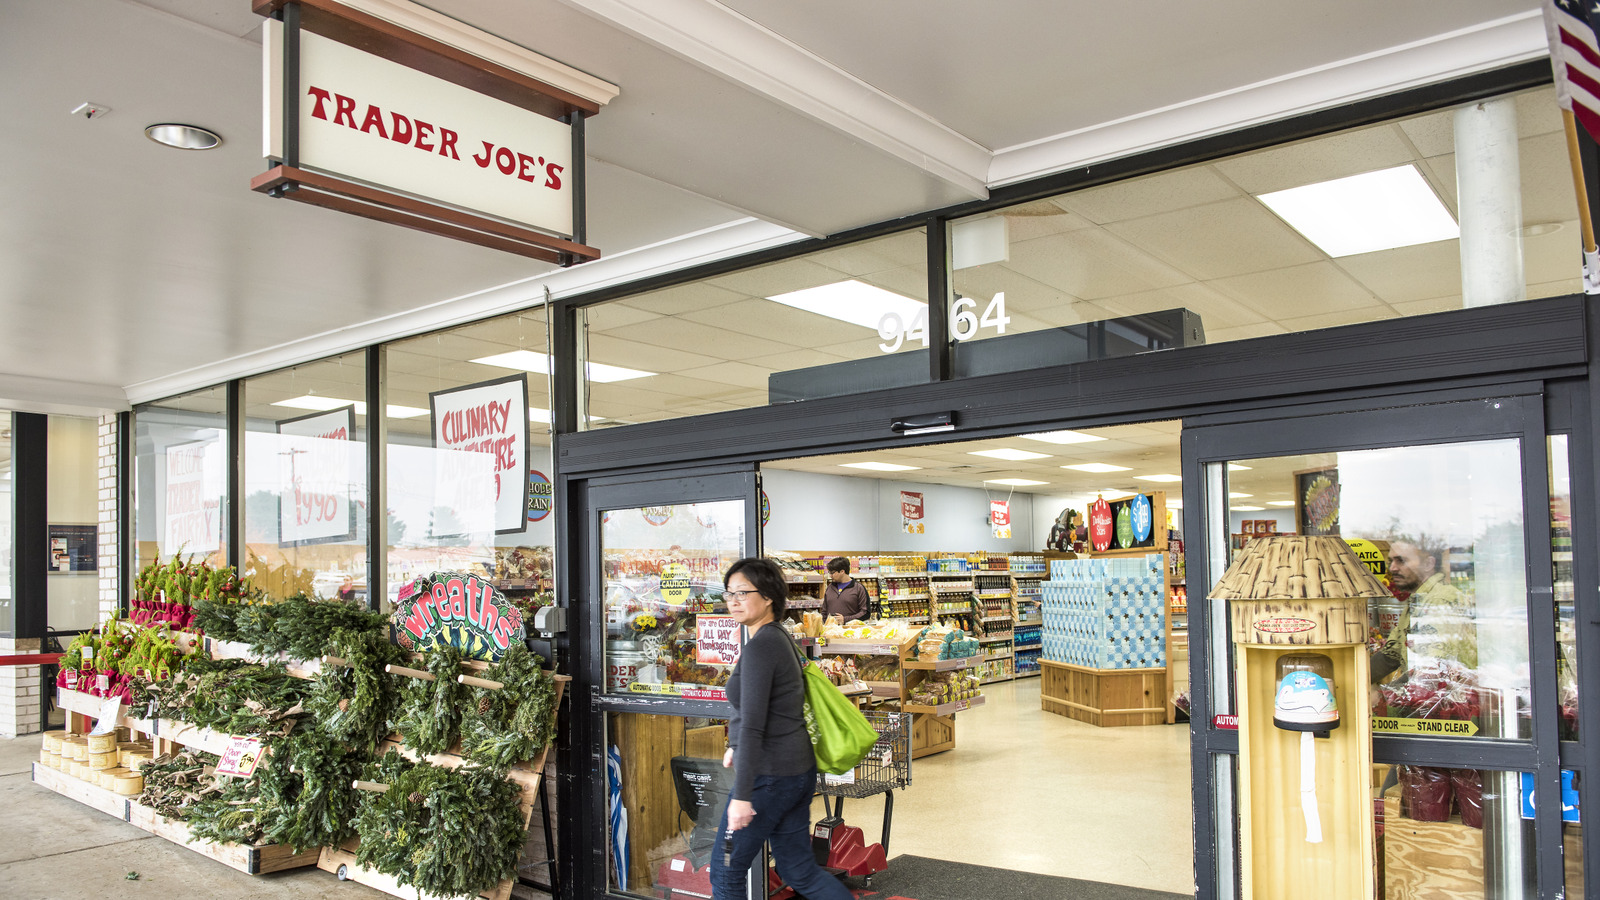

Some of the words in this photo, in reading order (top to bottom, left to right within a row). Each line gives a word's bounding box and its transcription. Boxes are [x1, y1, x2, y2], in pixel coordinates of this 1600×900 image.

[307, 85, 461, 161] TRADER
[472, 140, 564, 190] JOE'S
[441, 398, 512, 445] CULINARY
[529, 482, 551, 494] HOLE
[528, 498, 549, 510] RAIN
[661, 580, 689, 588] CAUTION
[405, 577, 514, 650] wreaths
[703, 629, 714, 639] ALL
[718, 630, 731, 640] DAY
[697, 639, 739, 655] Thanksgiving
[721, 652, 734, 664] Day
[607, 665, 636, 677] DER
[607, 677, 628, 688] E'S
[633, 683, 652, 691] AUTOMATIC
[702, 689, 712, 698] DOOR
[1378, 719, 1399, 730] DOOR
[1417, 721, 1443, 732] STAND
[1444, 722, 1470, 734] CLEAR
